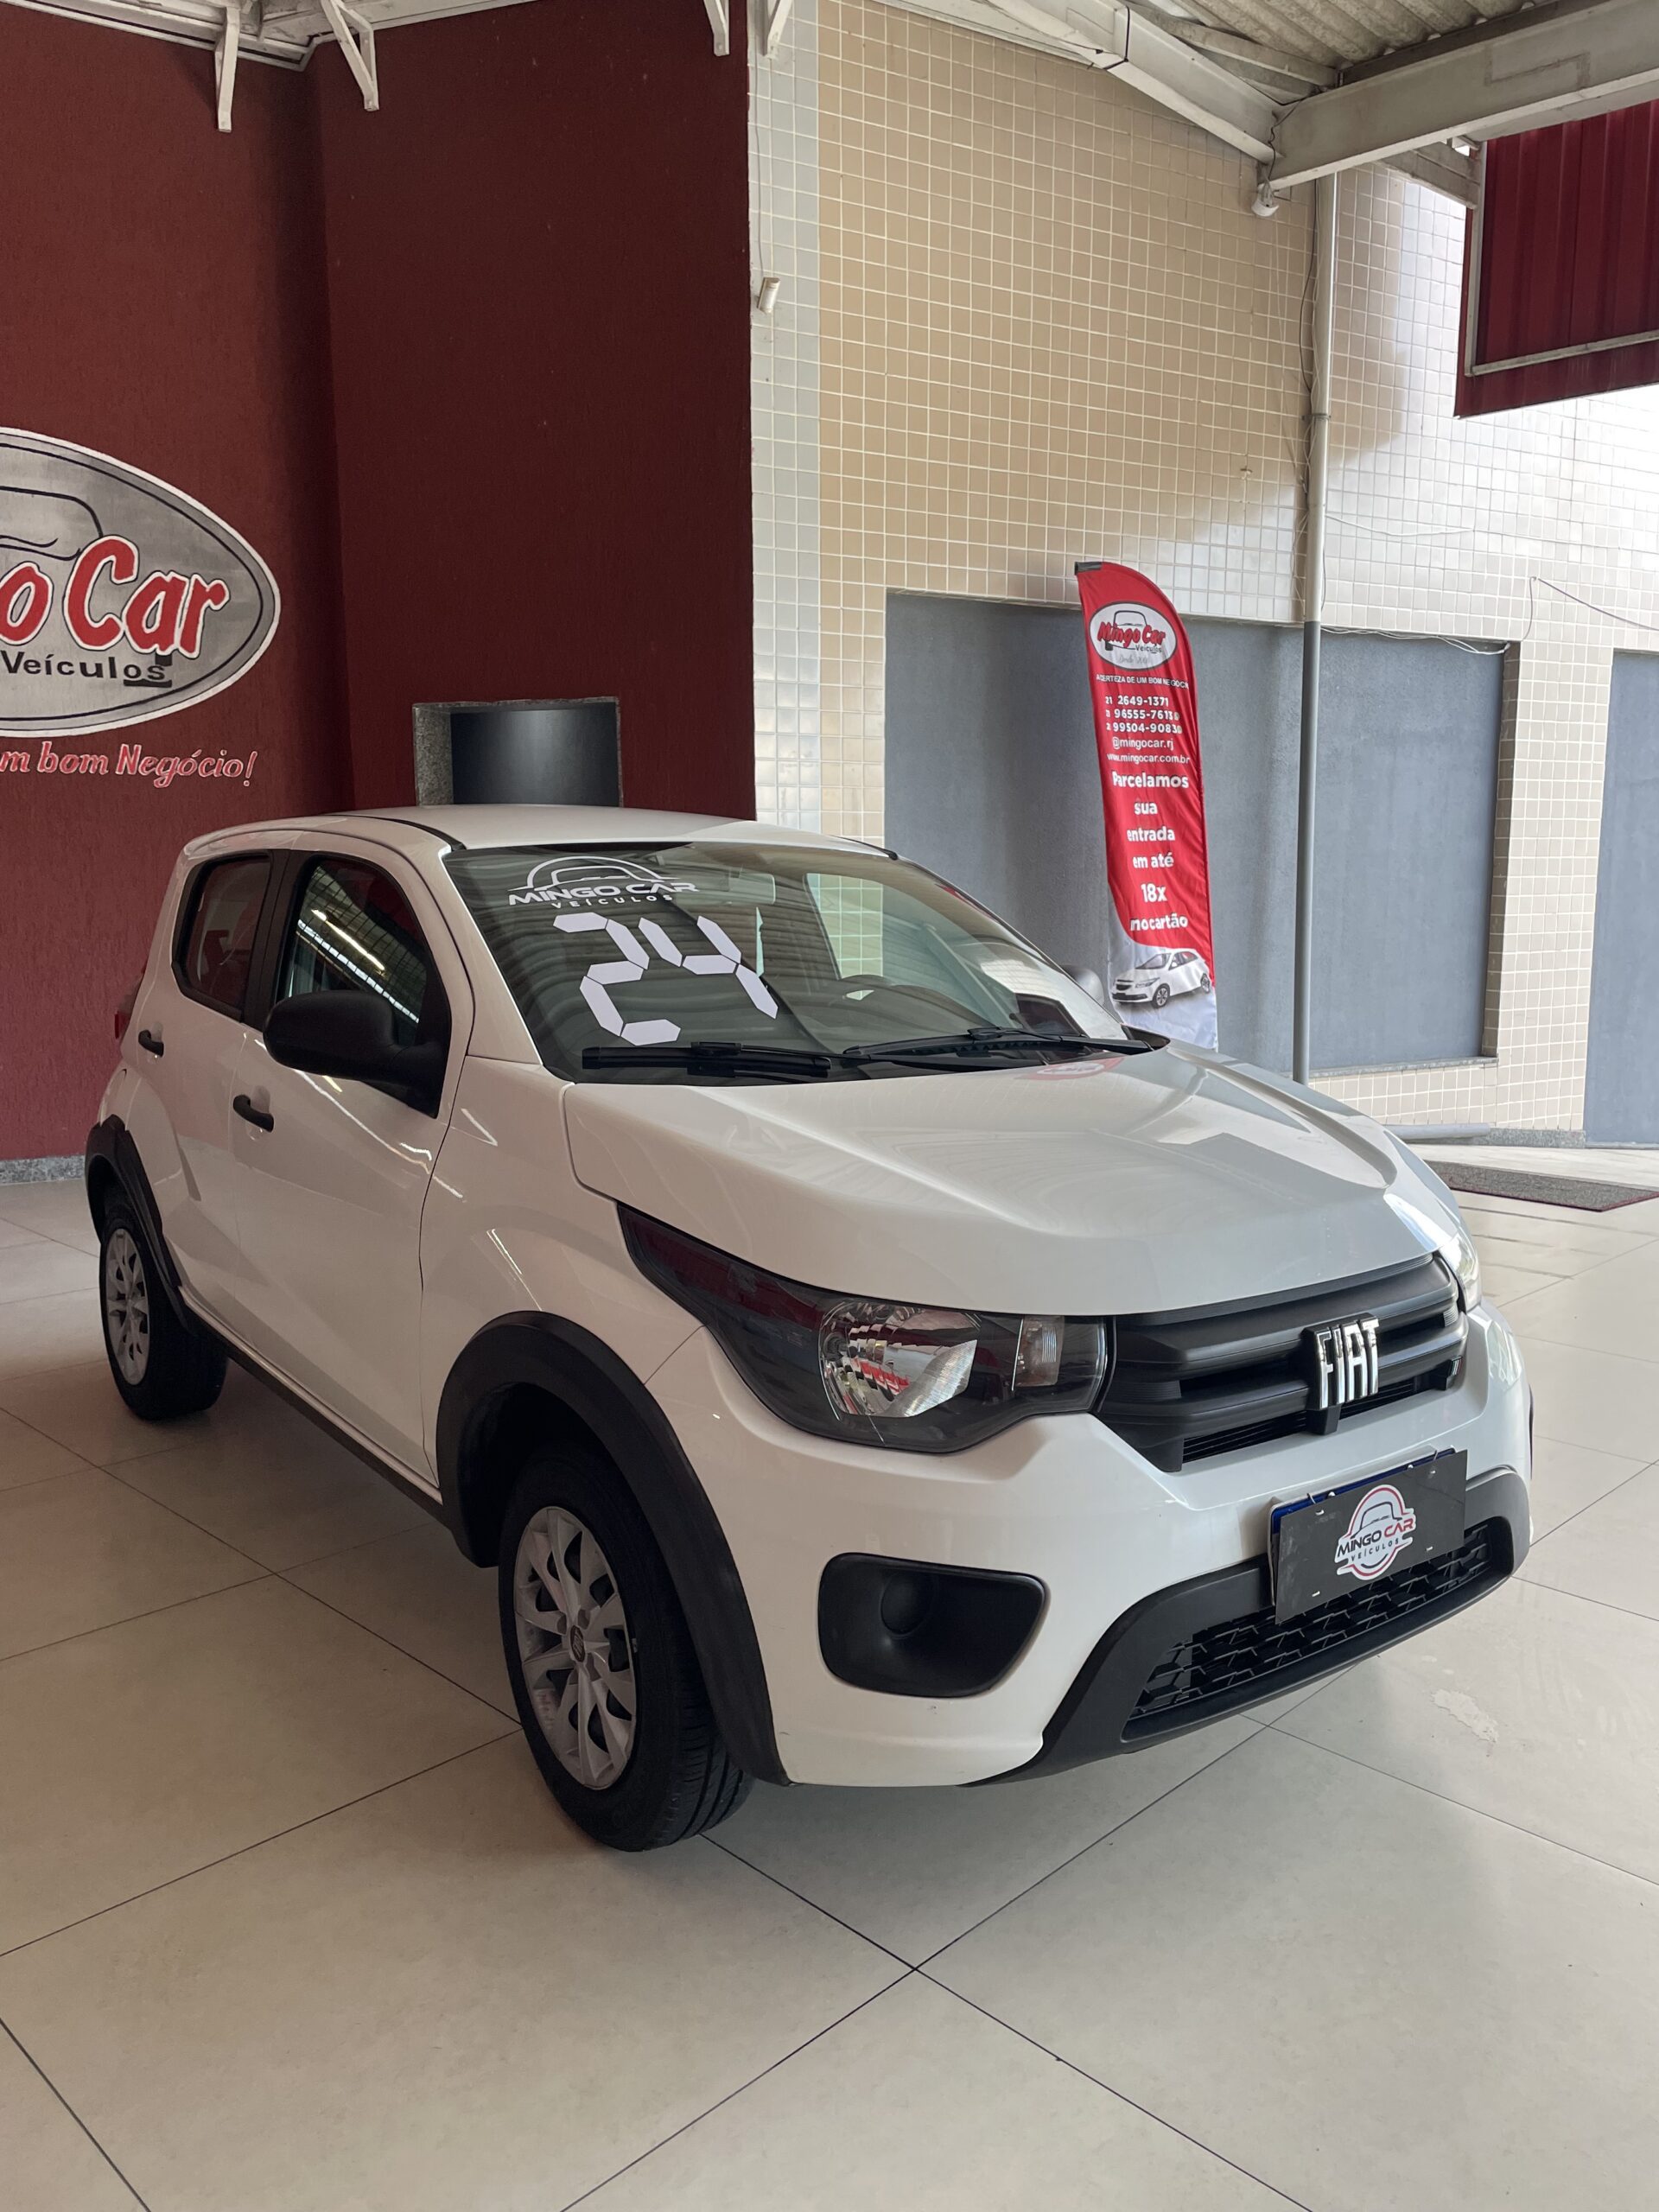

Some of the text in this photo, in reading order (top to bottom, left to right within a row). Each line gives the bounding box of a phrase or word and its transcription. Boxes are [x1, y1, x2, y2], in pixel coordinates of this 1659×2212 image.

[63, 535, 230, 659] Car
[1097, 621, 1166, 648] Mingo Car
[1, 651, 166, 682] Veículos
[1105, 695, 1169, 707] 21 2649-1371
[1114, 709, 1173, 721] 96555-7613
[1112, 722, 1178, 734] 99504-9083
[1112, 737, 1174, 751] @mingocar.rj
[37, 741, 109, 774] bom
[115, 744, 258, 788] Negócio!
[1112, 771, 1189, 789] Parcelamos
[1134, 801, 1158, 815] sua
[1127, 826, 1175, 842] entrada
[1133, 852, 1173, 868] em até
[509, 882, 699, 906] MINGO CAR
[1141, 883, 1167, 903] 18x
[1149, 912, 1188, 930] cartão
[553, 912, 779, 1046] 24
[1316, 1318, 1380, 1410] FIAT
[1337, 1517, 1414, 1558] MINGO CAR
